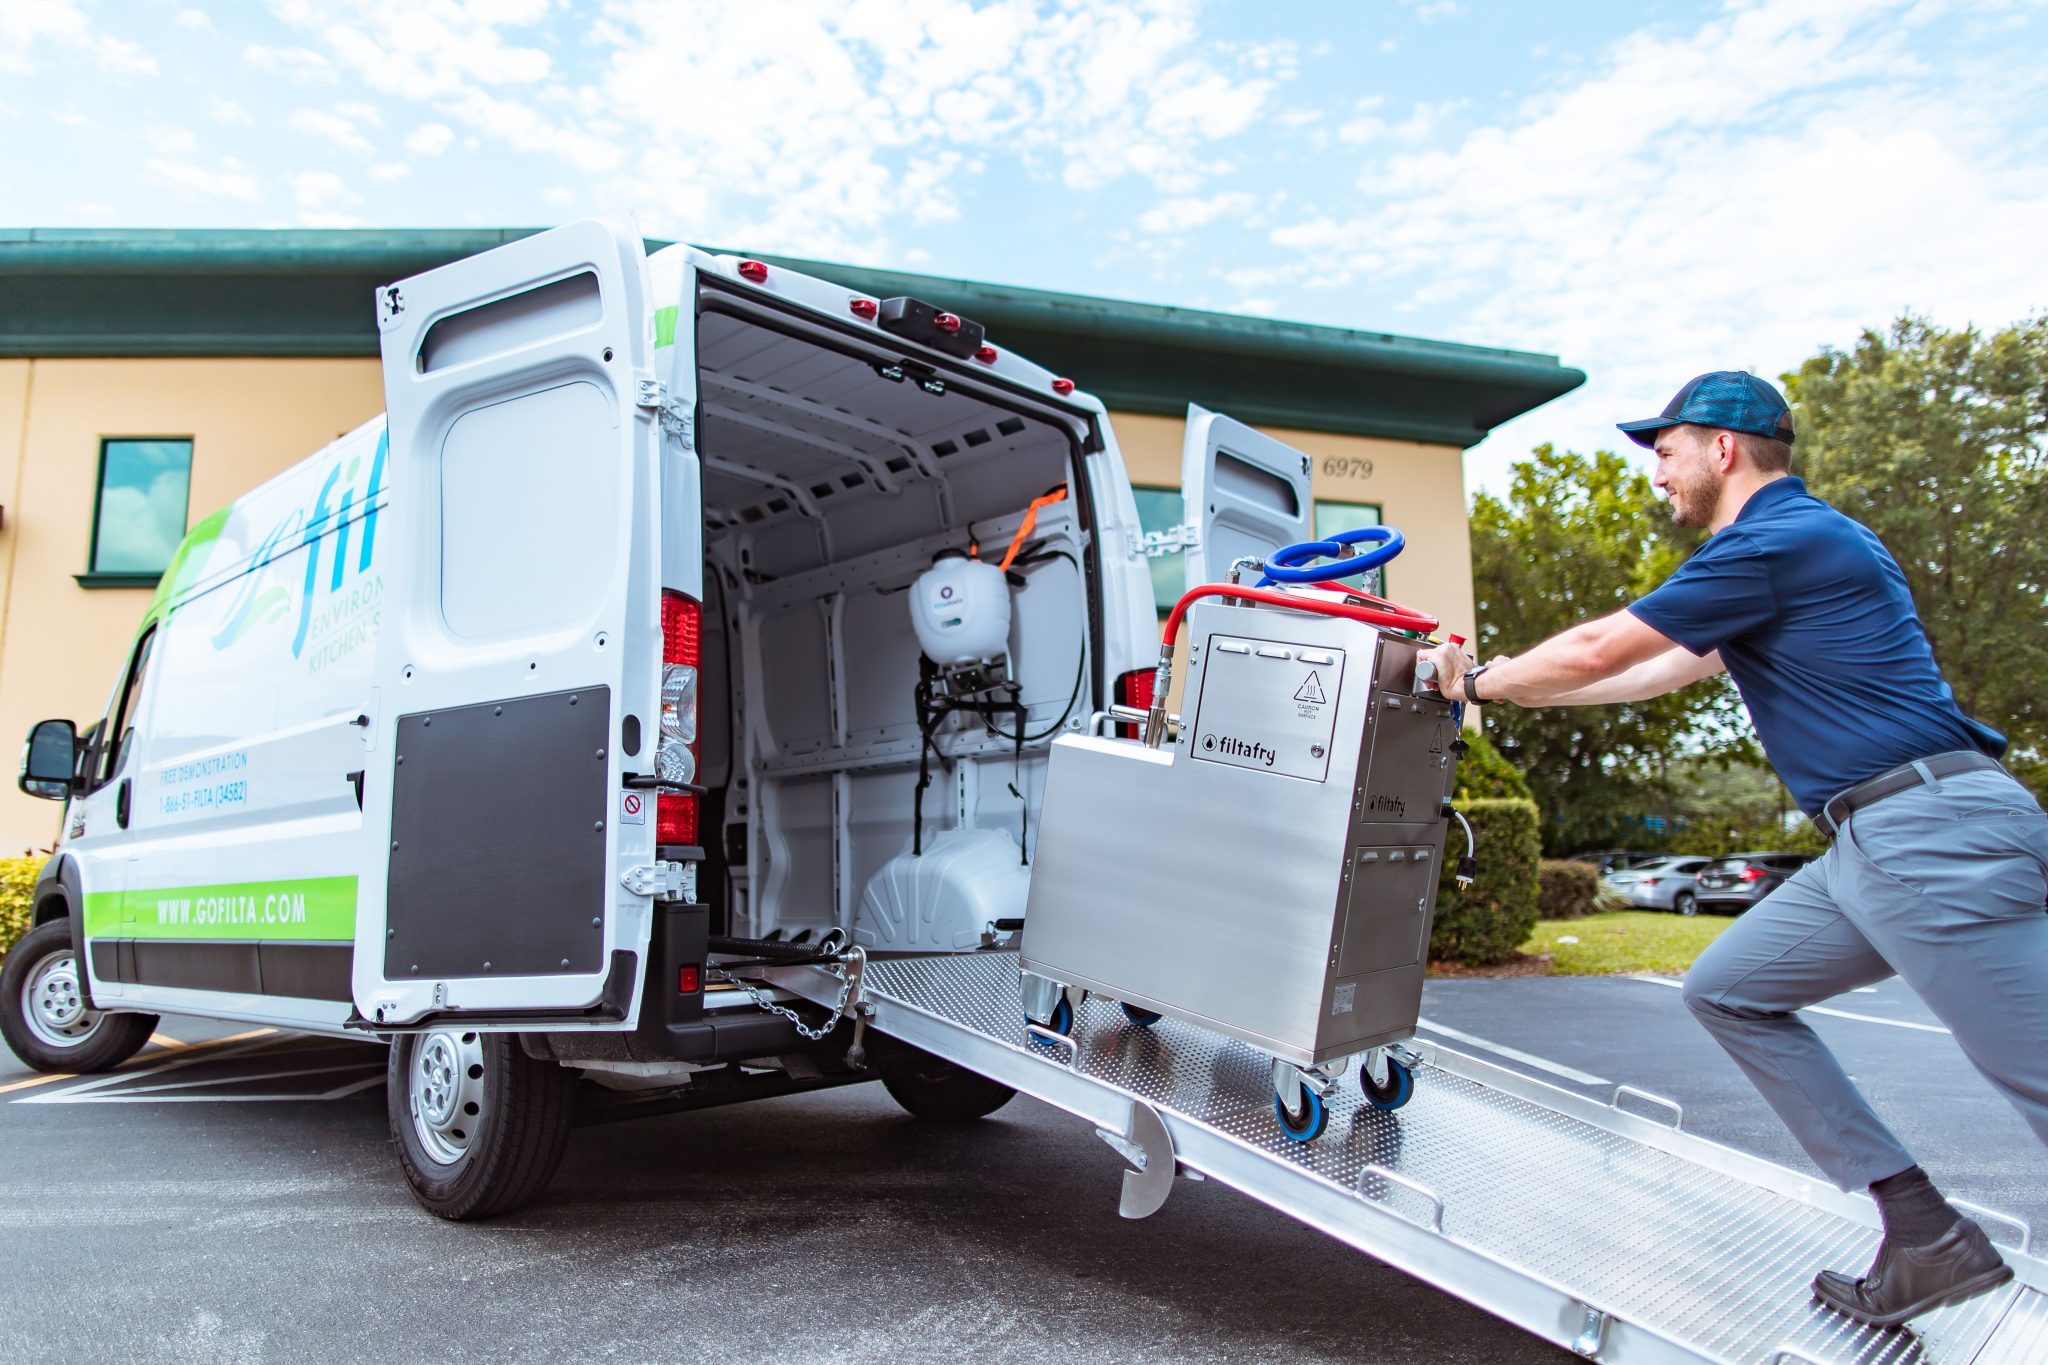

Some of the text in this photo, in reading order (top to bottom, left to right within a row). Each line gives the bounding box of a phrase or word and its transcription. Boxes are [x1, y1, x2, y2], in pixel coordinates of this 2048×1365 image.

[1322, 456, 1374, 480] 6979
[1219, 736, 1276, 767] filtafry
[160, 751, 248, 785] FREE DEMONSTRATION
[1376, 795, 1406, 818] filtafry
